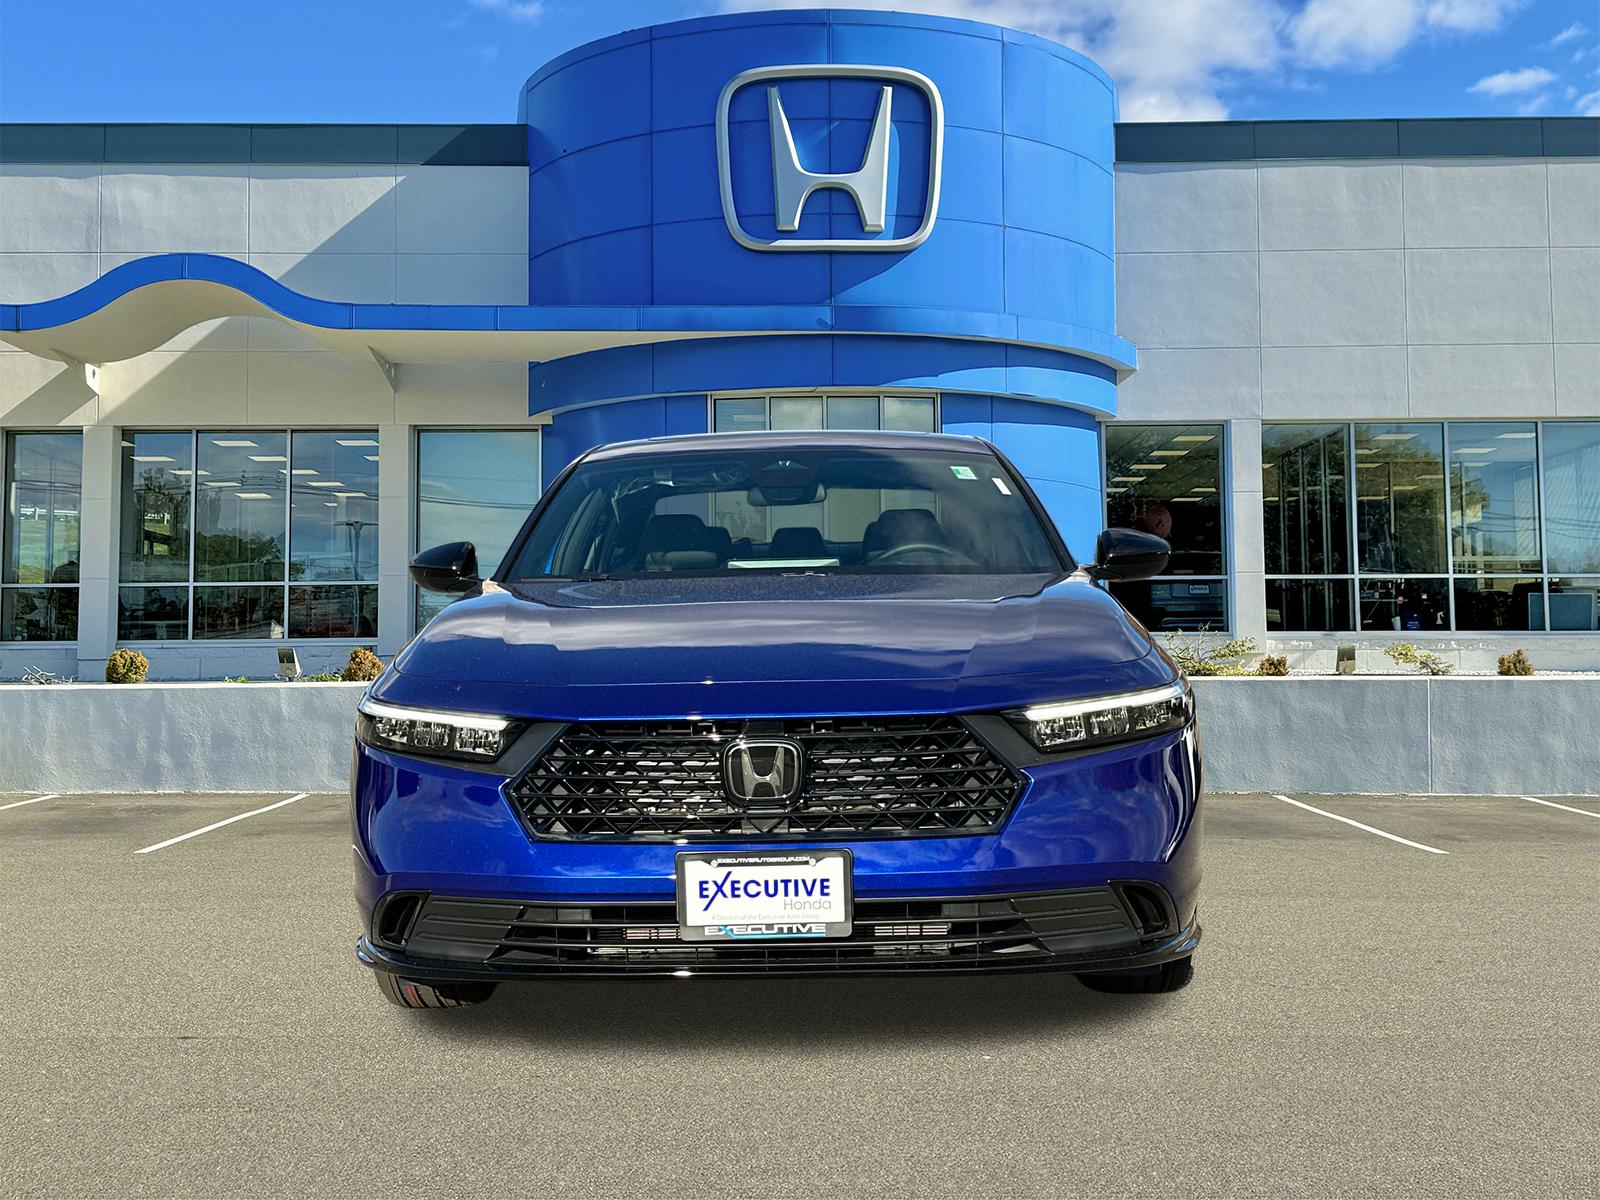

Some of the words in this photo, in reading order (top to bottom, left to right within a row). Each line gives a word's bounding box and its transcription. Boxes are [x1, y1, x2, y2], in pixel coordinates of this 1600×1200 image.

[699, 871, 830, 911] EXECUTIVE
[783, 898, 832, 910] Honda
[704, 923, 826, 937] EXECUTIVE
